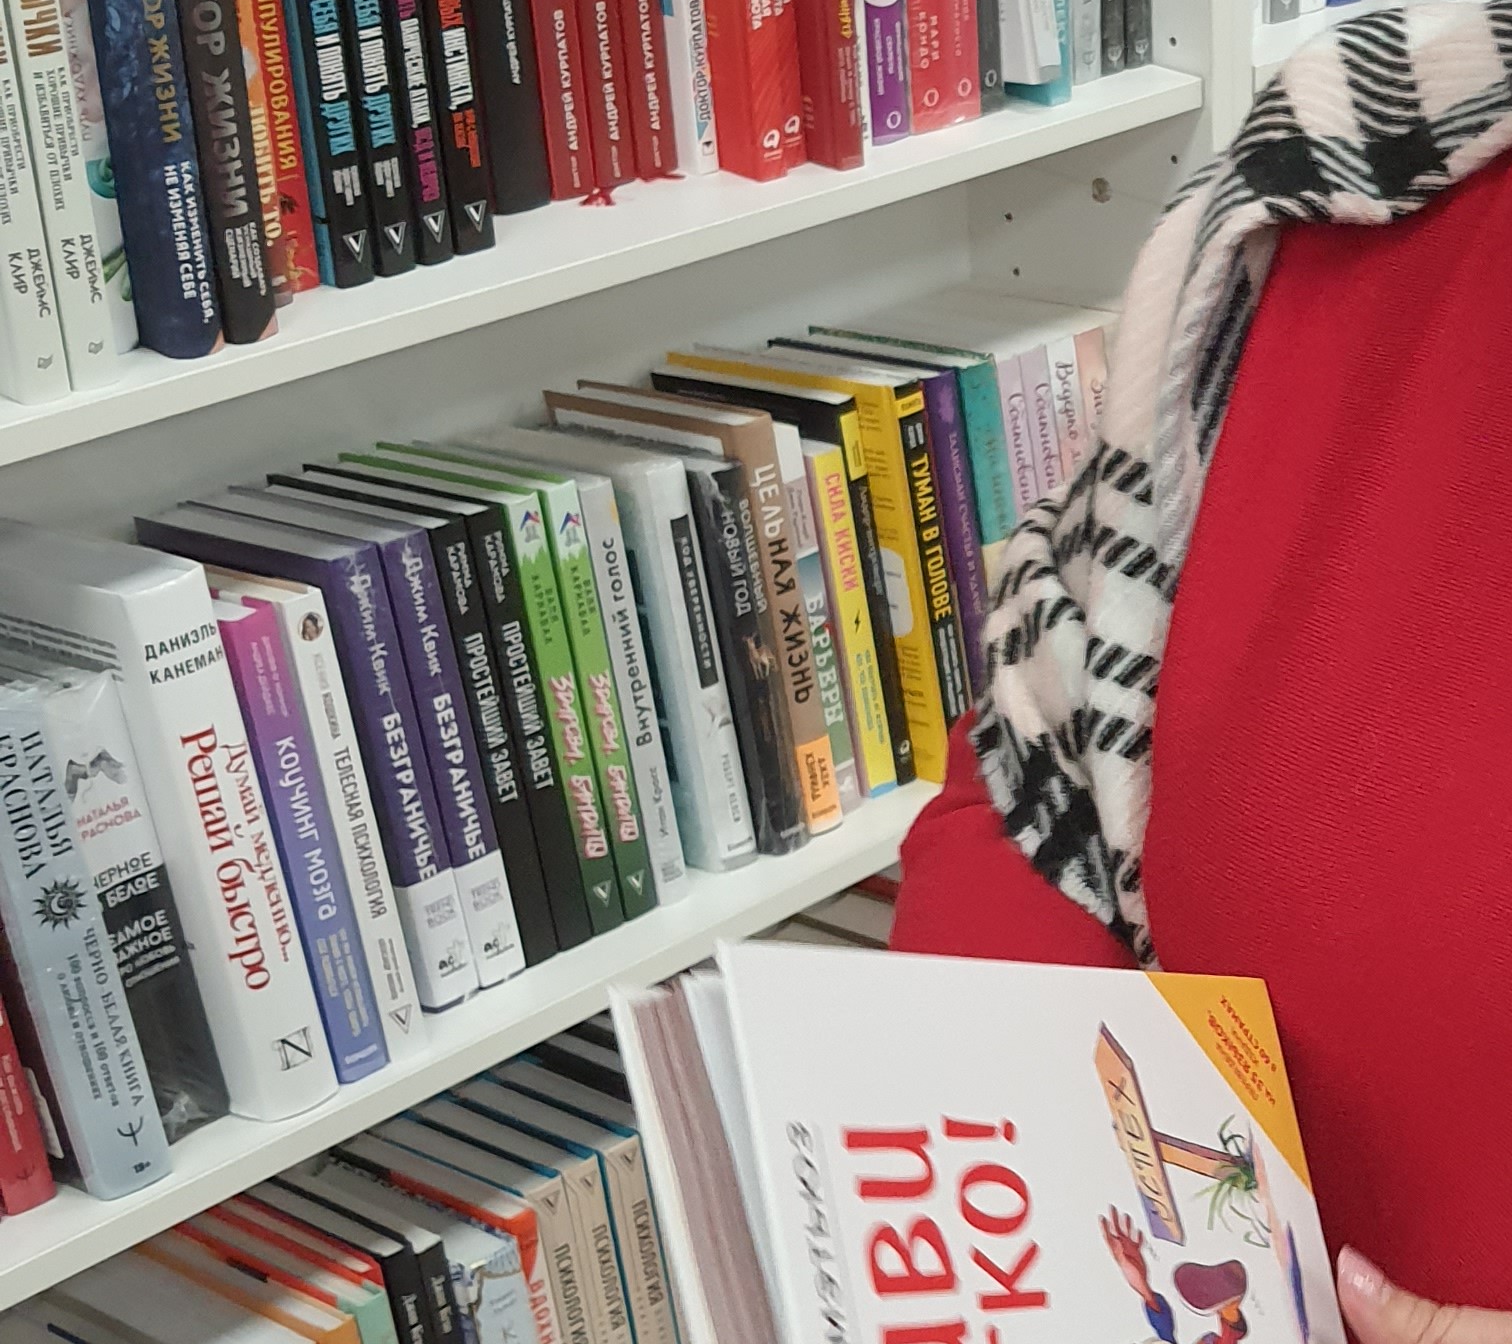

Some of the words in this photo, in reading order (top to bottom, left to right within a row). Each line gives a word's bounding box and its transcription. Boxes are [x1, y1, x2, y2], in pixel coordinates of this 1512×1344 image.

[919, 11, 930, 70] КОНДО
[928, 14, 940, 62] МАРИ
[149, 35, 182, 144] ЖИЗНИ
[315, 46, 349, 101] ПОНЯТЬ
[201, 67, 249, 218] ЖИЗНИ
[8, 252, 29, 295] КЛИР
[27, 248, 51, 318] ДЖЕЙМС
[60, 237, 81, 281] КЛИР
[79, 233, 102, 305] ДЖЕЙМС
[911, 453, 937, 524] ТУМАН
[823, 472, 845, 523] СИЛА
[834, 527, 859, 592] КИСКИ
[923, 526, 932, 541] В
[733, 580, 752, 617] ГОД
[751, 462, 795, 597] ЦЕЛЬНАЯ
[779, 607, 812, 704] ЖИЗНЬ
[925, 545, 953, 622] ГОЛОВЕ
[144, 622, 218, 662] ДАНИЭЛЬ
[149, 644, 225, 685] КАНЕМАН
[368, 642, 391, 696] Квик
[490, 747, 519, 804] ЗАВЕТ
[526, 735, 555, 790] ЗАВЕТ
[20, 729, 74, 857] НАТАЛЬЯ
[179, 723, 236, 854] Решай
[215, 856, 272, 991] быстро
[350, 821, 387, 919] ПСИХОЛОГИЯ
